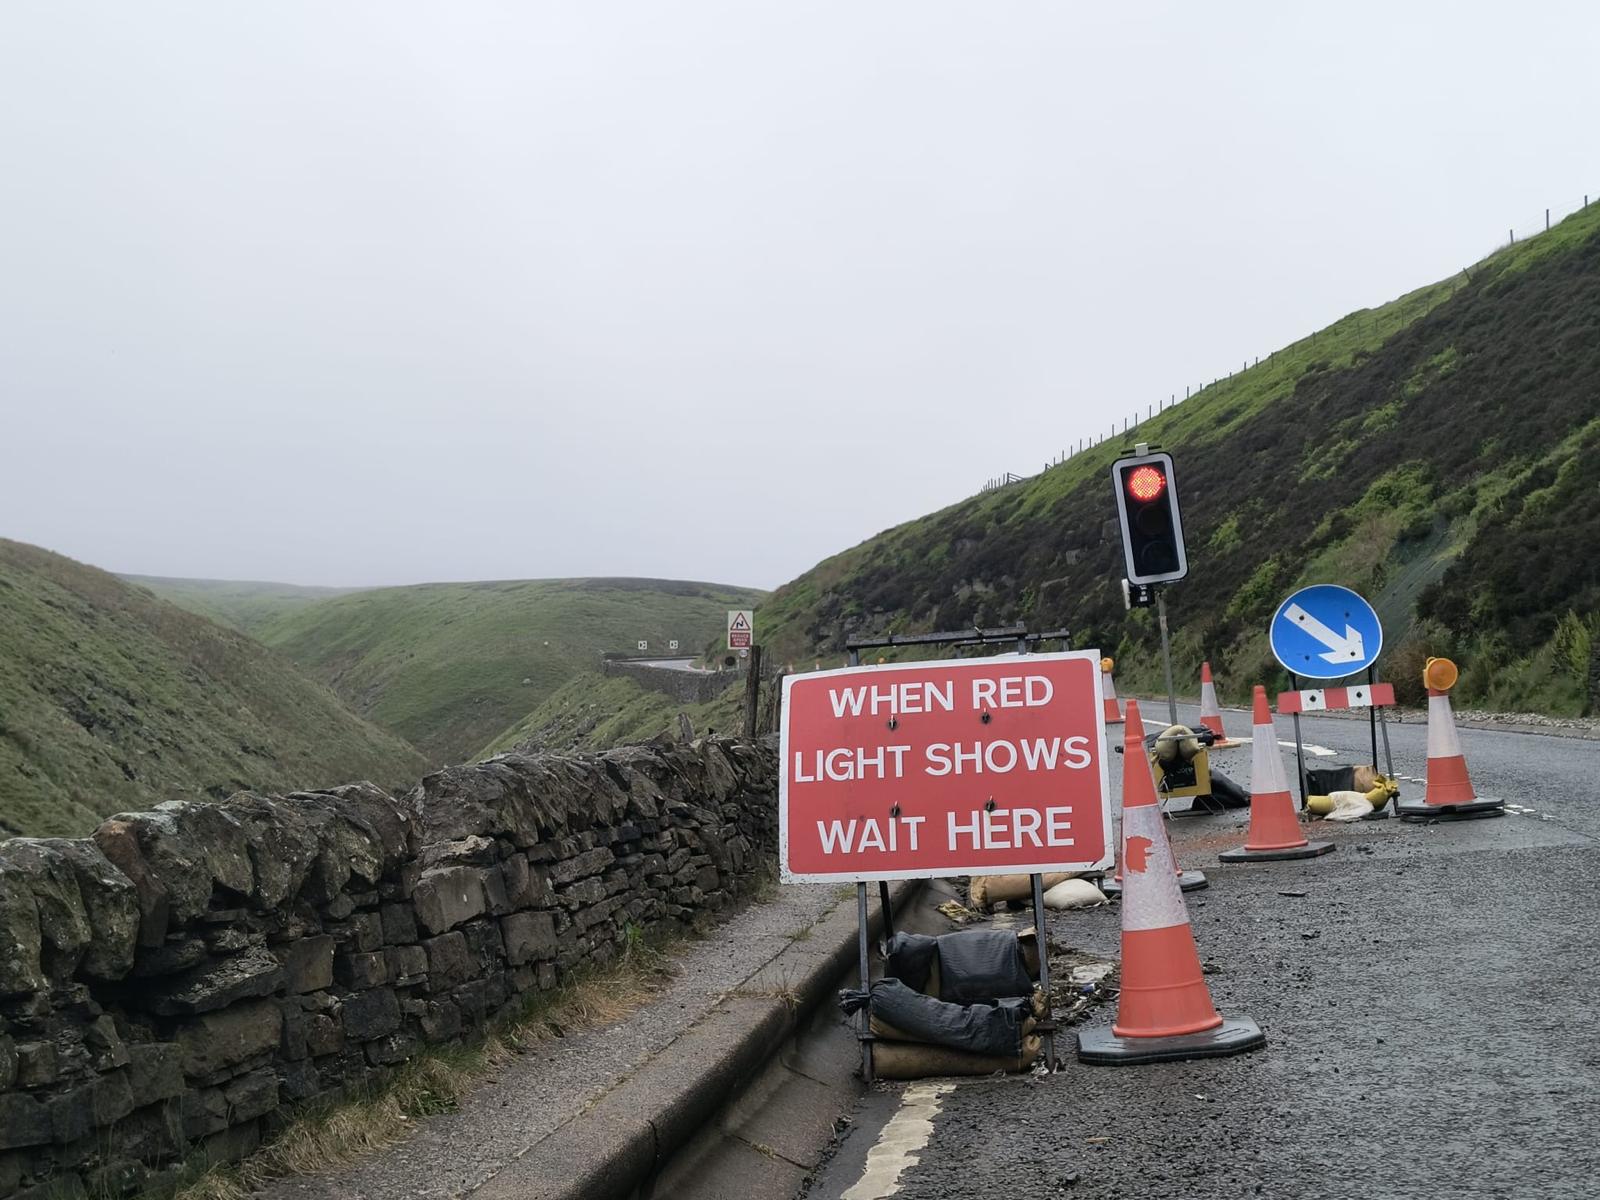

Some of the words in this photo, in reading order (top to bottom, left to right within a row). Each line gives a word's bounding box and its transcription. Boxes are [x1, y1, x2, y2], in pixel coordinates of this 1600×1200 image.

[829, 680, 954, 717] WHEN
[972, 675, 1054, 709] RED
[795, 745, 911, 782] LIGHT
[925, 736, 1092, 776] SHOWS
[816, 816, 926, 854] WAIT
[947, 806, 1075, 851] HERE
